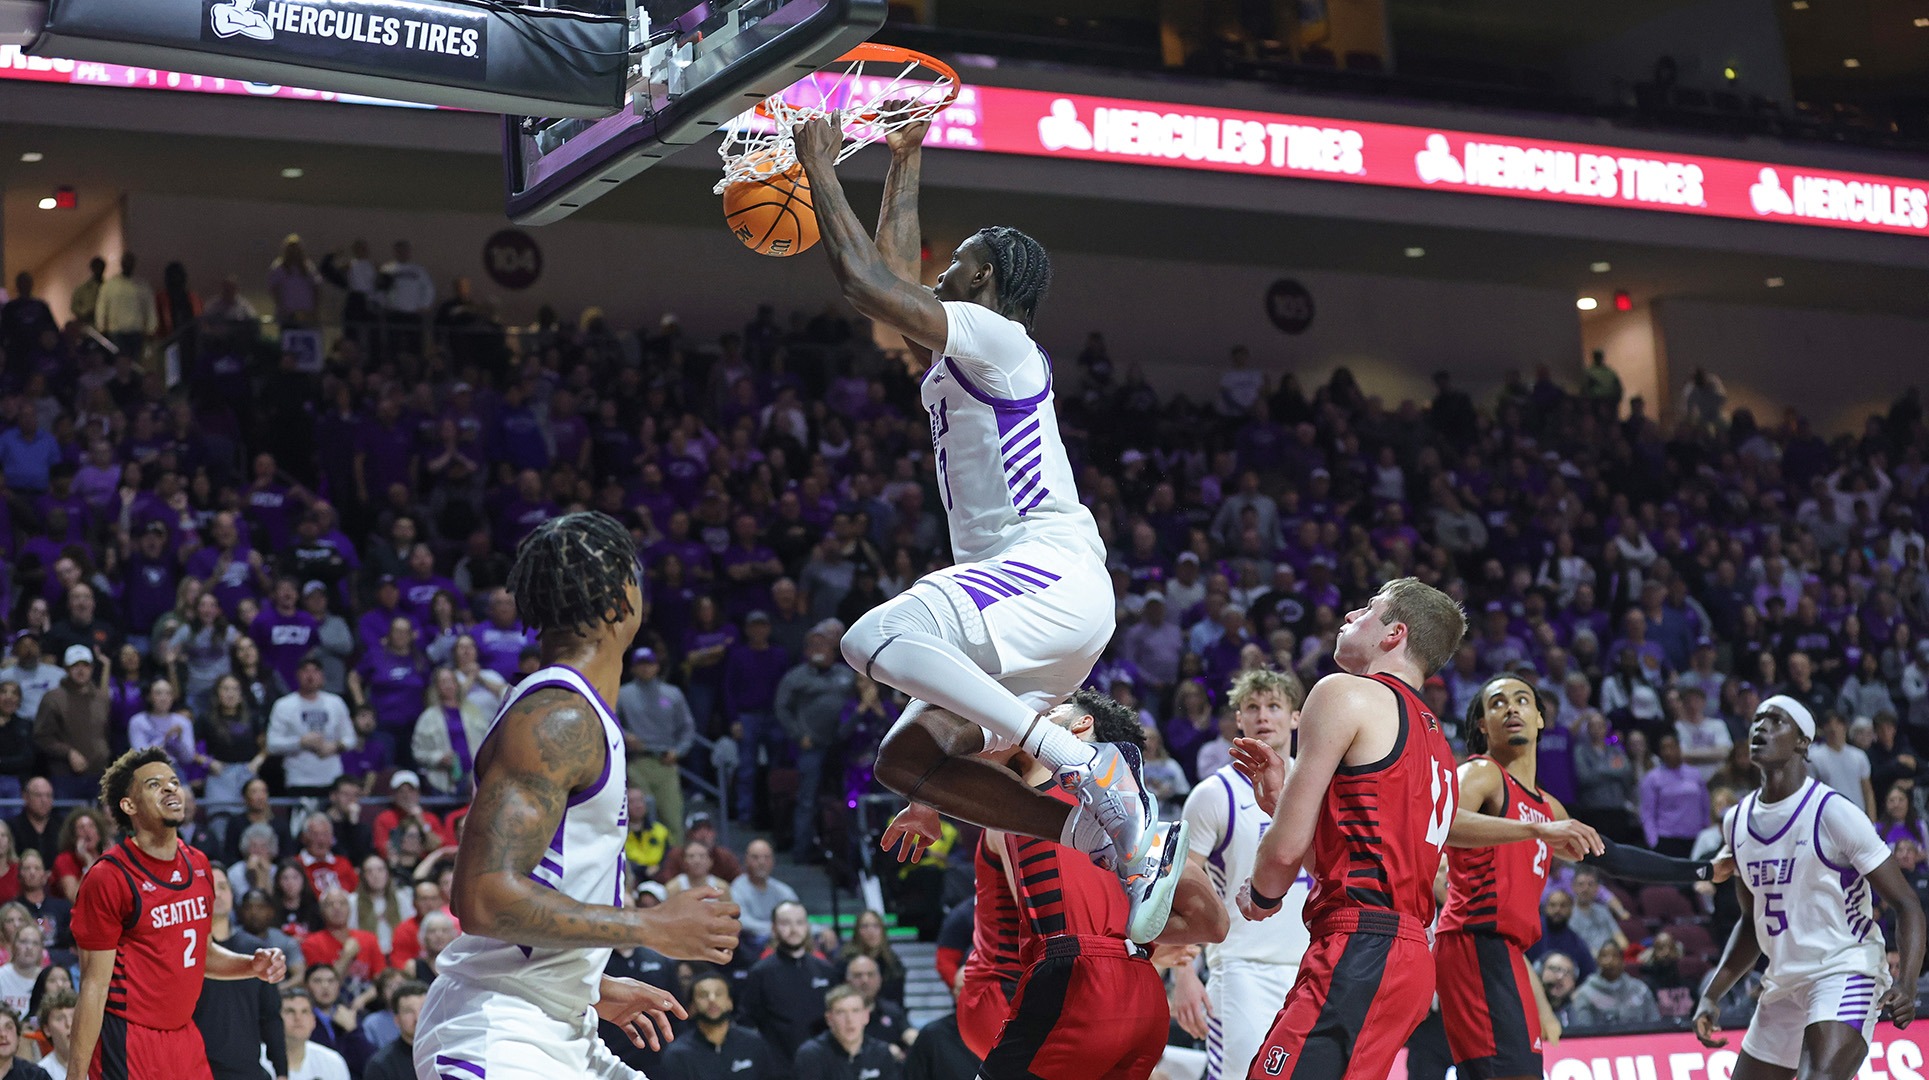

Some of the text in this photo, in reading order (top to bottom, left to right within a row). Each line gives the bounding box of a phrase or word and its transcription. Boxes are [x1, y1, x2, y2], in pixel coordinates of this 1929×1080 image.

[267, 1, 479, 57] HERCULES TIRES
[1093, 107, 1364, 174] HERCULES TIRES
[1464, 142, 1705, 207] HERCULES TIRES
[1793, 175, 1928, 229] HERCULES
[1747, 857, 1797, 887] GCU
[151, 896, 208, 929] SEATTLE
[1764, 893, 1788, 937] 5
[183, 928, 197, 968] 2
